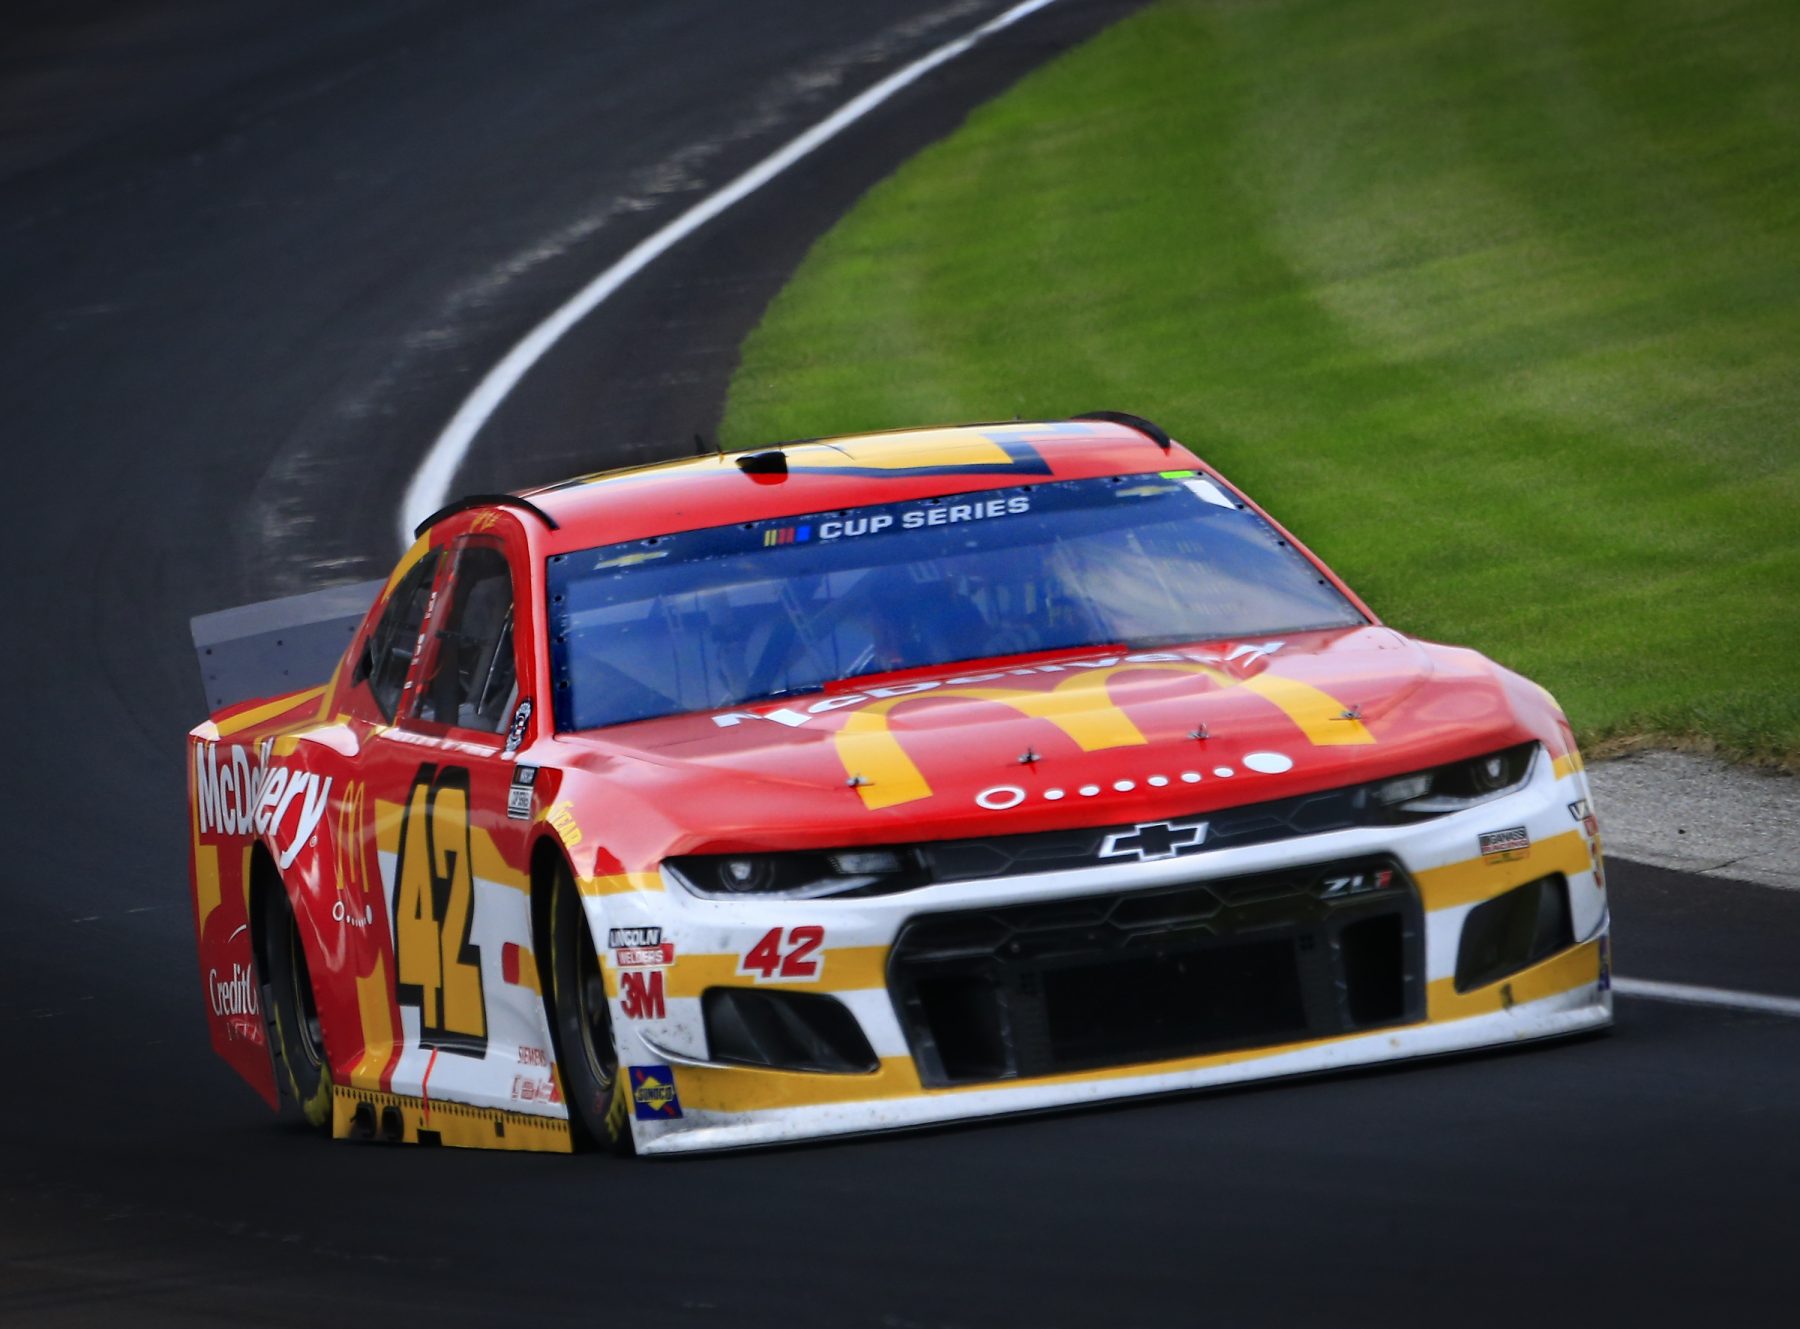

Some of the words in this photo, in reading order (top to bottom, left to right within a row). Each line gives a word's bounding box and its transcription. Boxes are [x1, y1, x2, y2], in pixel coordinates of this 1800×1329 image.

[819, 515, 893, 540] CUP
[902, 496, 1030, 529] SERIES
[397, 765, 488, 1052] 42
[610, 928, 660, 948] LINCOLN
[742, 925, 825, 978] 42
[209, 963, 259, 1016] CreditO
[620, 970, 667, 1020] 3M
[636, 1086, 674, 1102] SUNOCO
